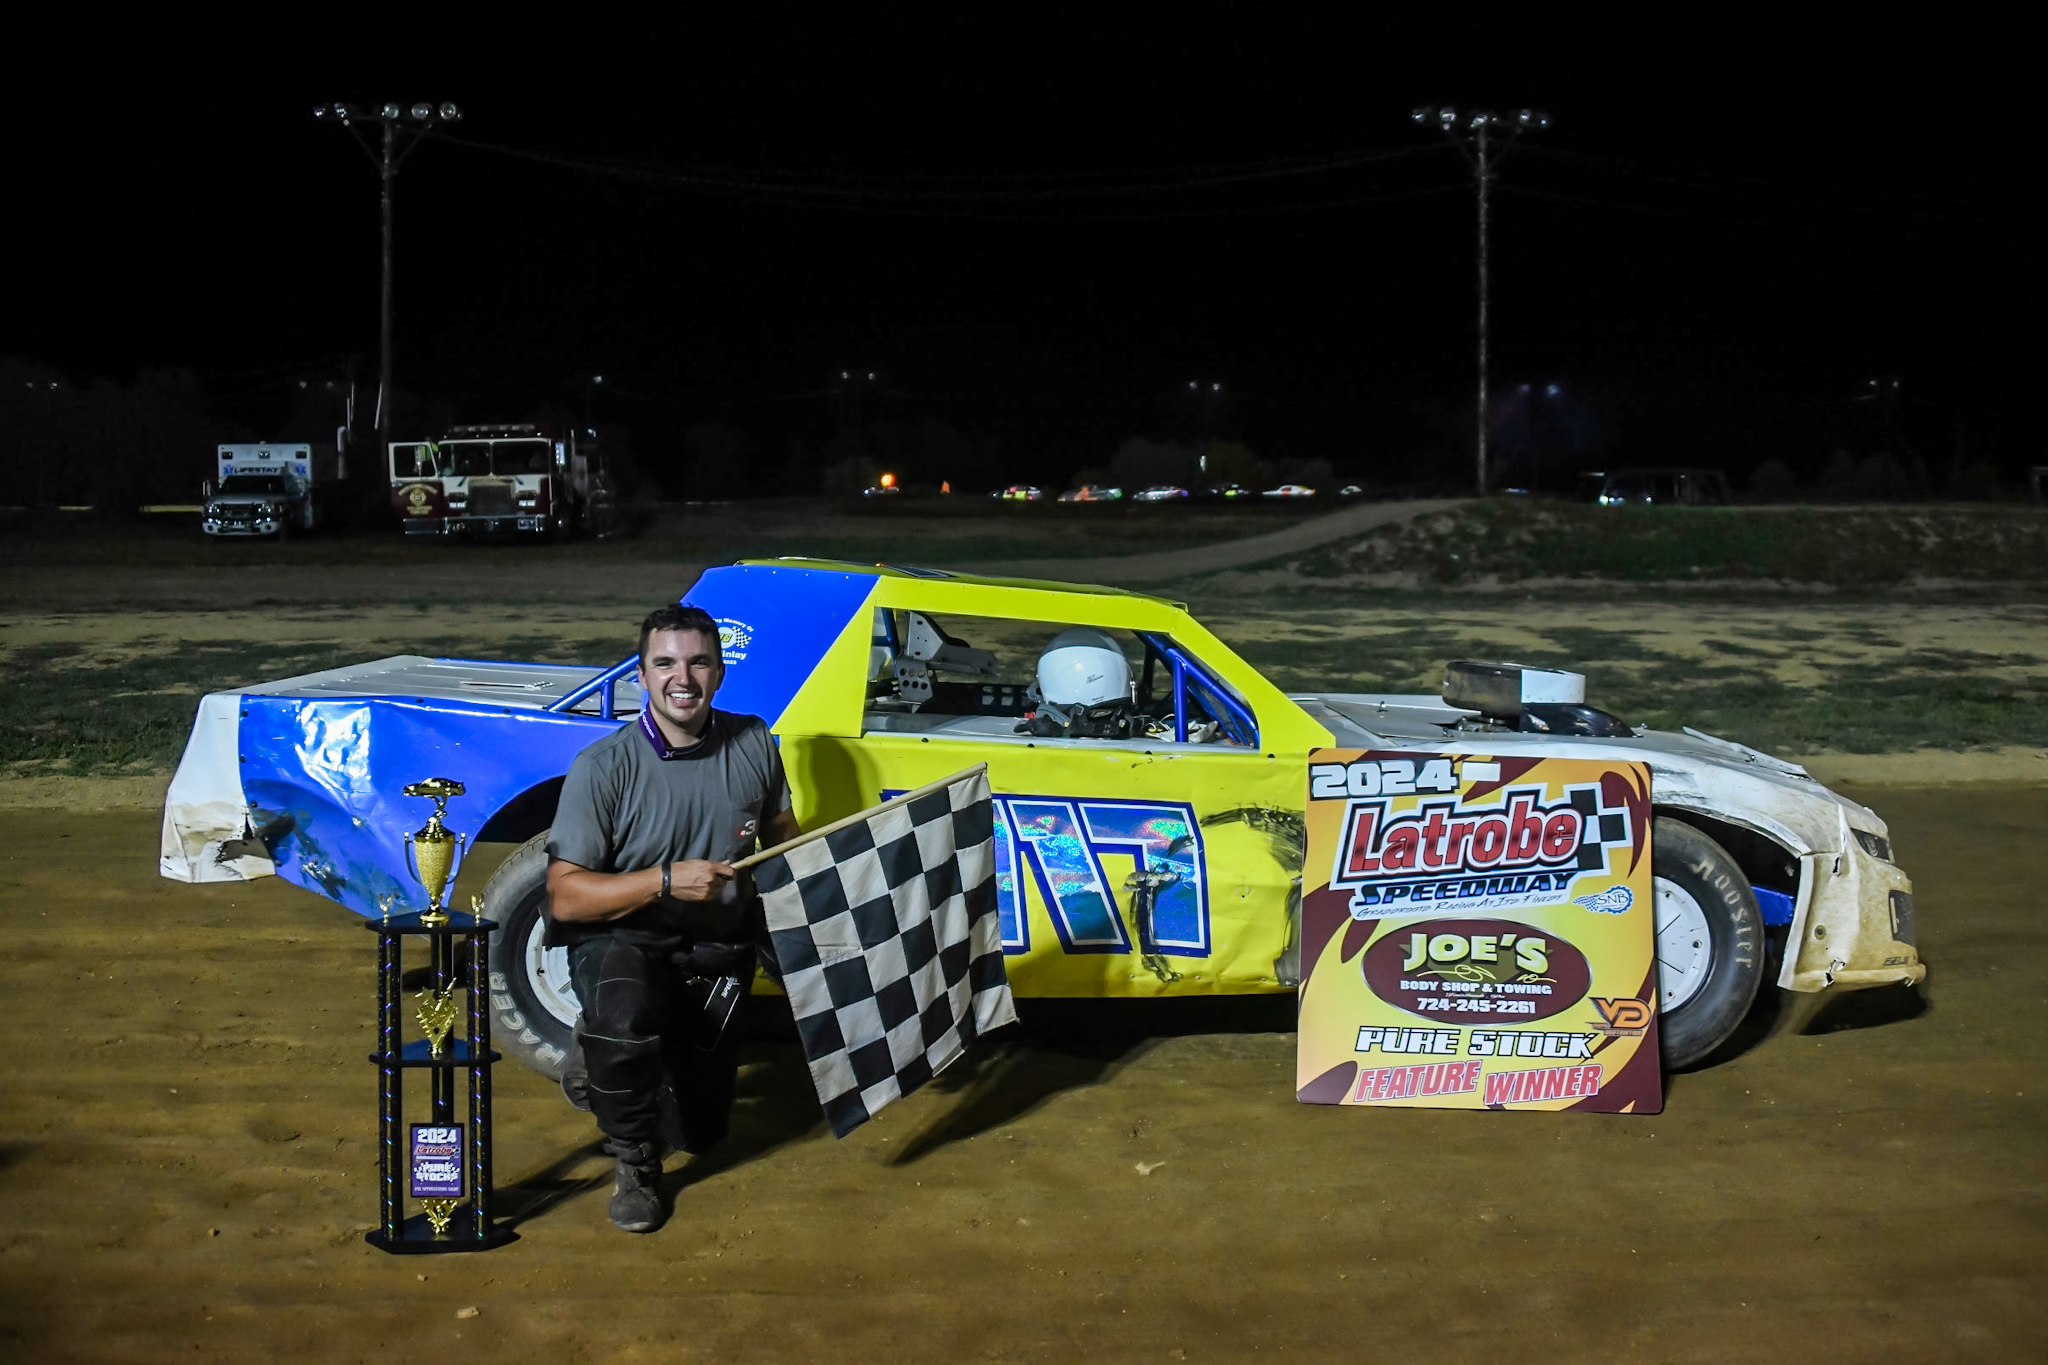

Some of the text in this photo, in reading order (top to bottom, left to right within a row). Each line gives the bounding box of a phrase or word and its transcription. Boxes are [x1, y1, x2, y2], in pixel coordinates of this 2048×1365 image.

[234, 466, 279, 474] LIFESTAT
[721, 649, 747, 660] inlay
[1311, 758, 1460, 799] 2024
[1347, 798, 1580, 876] Latrobe
[1355, 871, 1578, 907] SPEEDWAY
[1597, 893, 1629, 905] SNB
[1402, 931, 1549, 975] JOE'S
[1400, 979, 1552, 995] BODY SHOP & TOWING
[1417, 996, 1536, 1015] 724-245-2261
[489, 971, 567, 1068] RACER
[1355, 1025, 1459, 1056] PURE
[1468, 1029, 1600, 1060] STOCK
[1353, 1059, 1603, 1106] FEATURE WINNER
[417, 1127, 457, 1144] 2024
[422, 1163, 452, 1172] PURE
